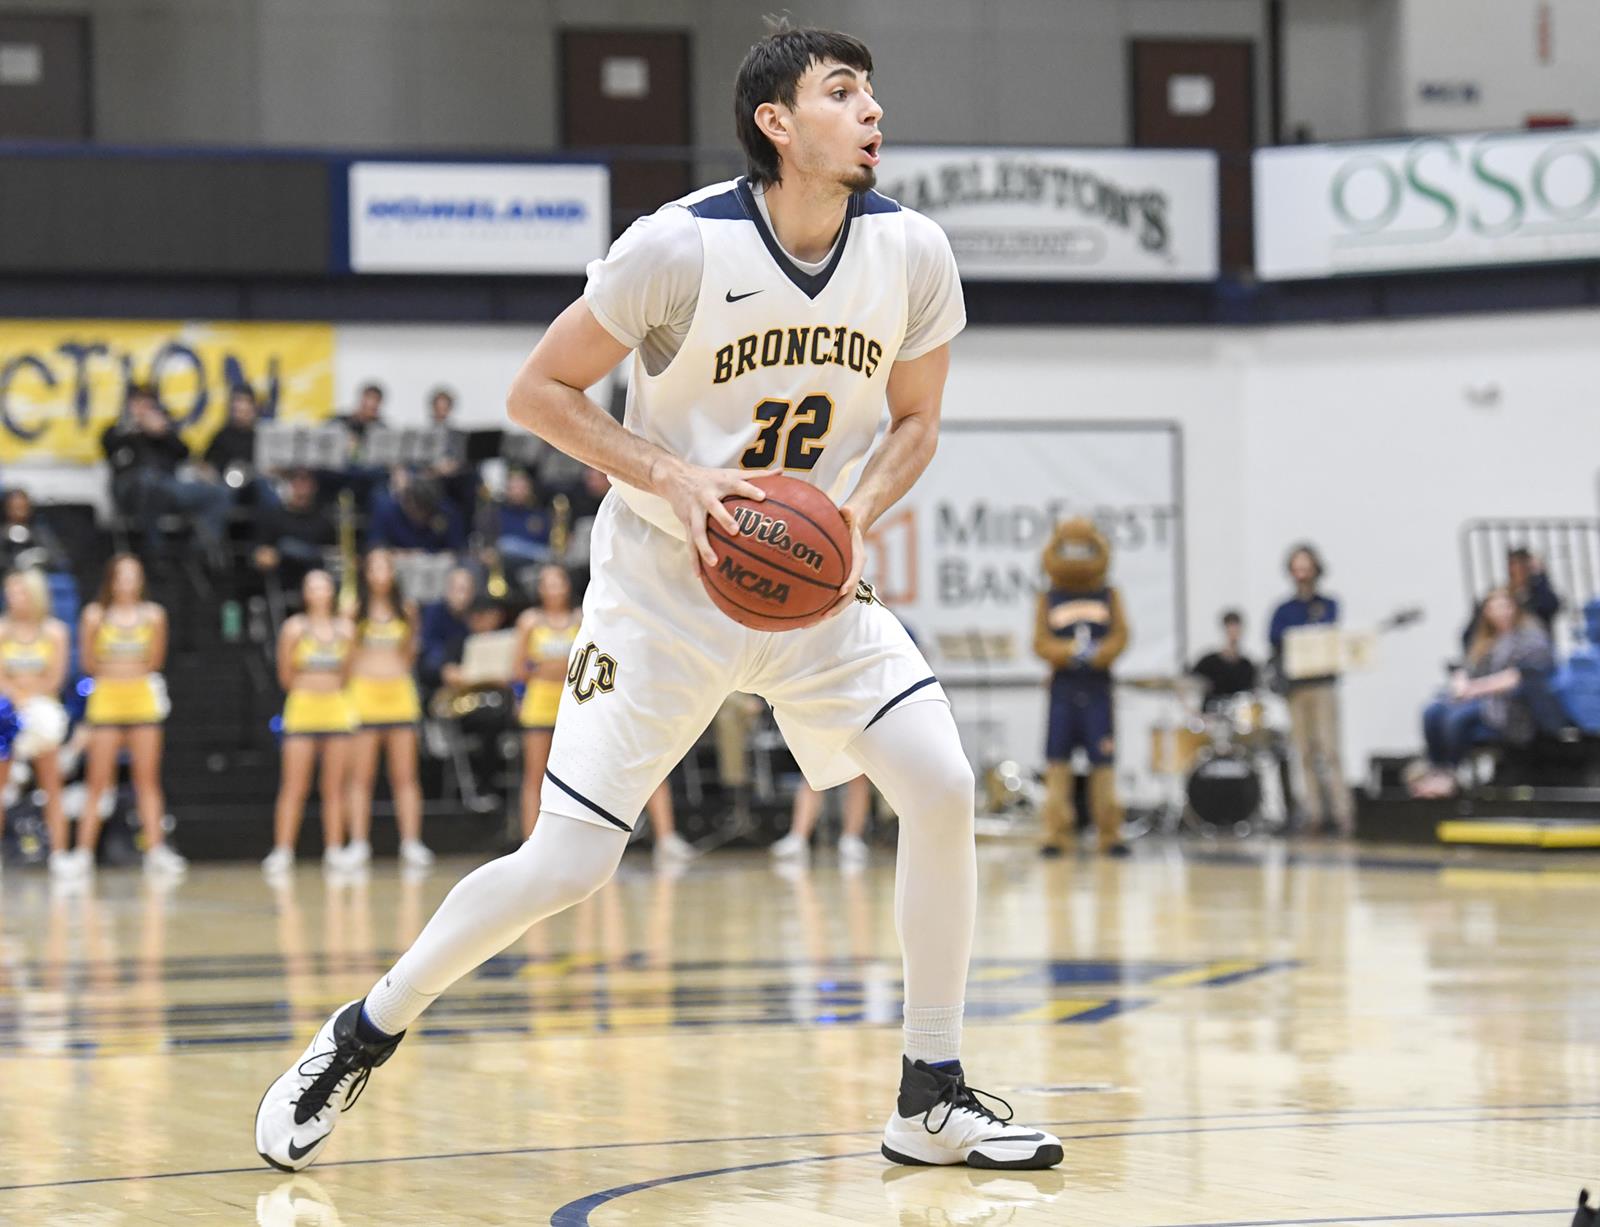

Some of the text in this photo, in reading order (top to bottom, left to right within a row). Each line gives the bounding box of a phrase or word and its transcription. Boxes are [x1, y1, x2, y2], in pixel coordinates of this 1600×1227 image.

[737, 390, 836, 473] 32
[734, 505, 825, 574] Wilson
[718, 555, 791, 604] NCAA
